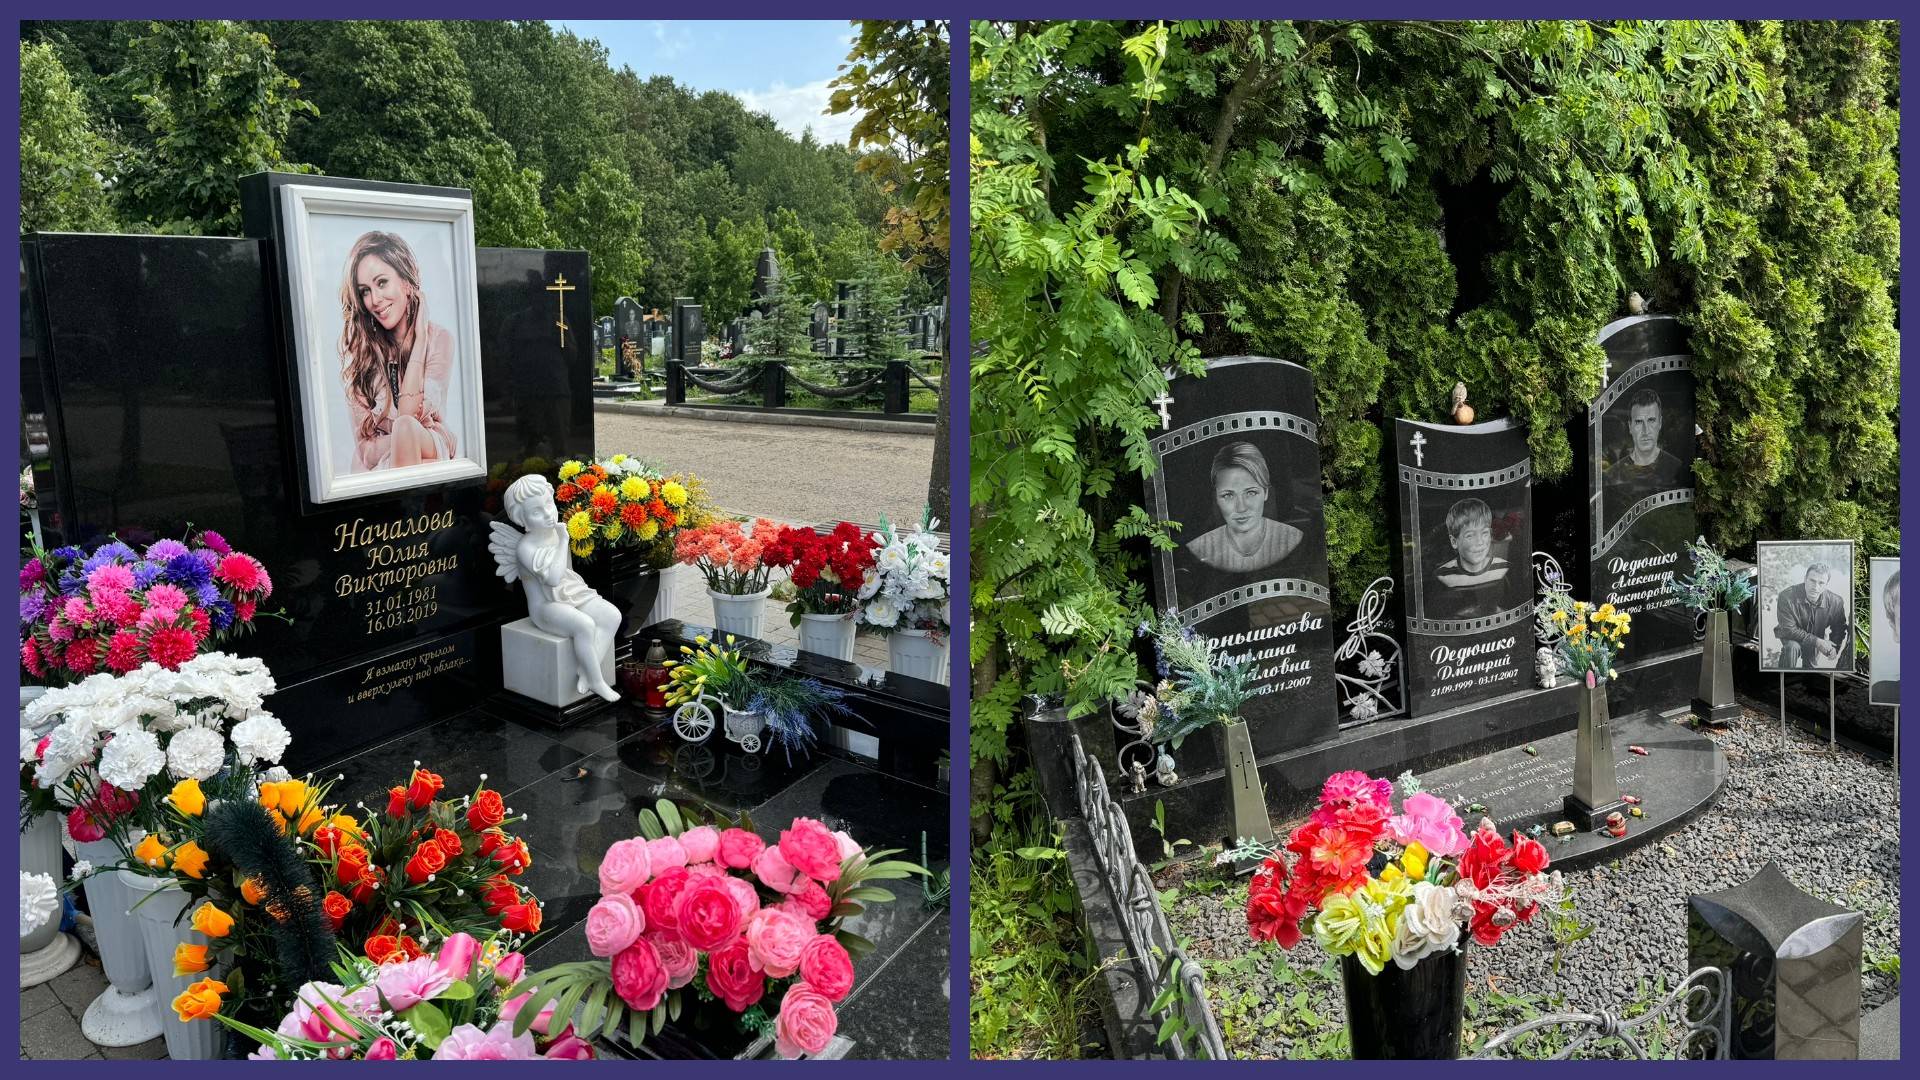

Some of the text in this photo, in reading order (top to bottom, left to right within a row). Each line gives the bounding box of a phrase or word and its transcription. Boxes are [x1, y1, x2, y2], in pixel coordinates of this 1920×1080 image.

[333, 509, 455, 551] Началова
[367, 542, 430, 570] Юлия
[1607, 552, 1678, 577] Дедюшко
[335, 554, 459, 597] Викторовна
[1611, 570, 1674, 590] Александр
[365, 585, 438, 618] 31.01.1981
[366, 602, 439, 635] 16.03.2019
[1206, 611, 1324, 650] рнышкова
[361, 643, 455, 684] Я взмахну крылом
[1430, 636, 1517, 666] Дедюшко
[1437, 654, 1511, 681] Дмитрий
[347, 695, 354, 704] и
[357, 683, 386, 700] вверх
[386, 674, 413, 695] улечу
[415, 664, 432, 681] под
[1430, 679, 1474, 697] 21.09.1999
[1478, 669, 1519, 686] 03.11.2007
[1430, 779, 1465, 794] ердце
[1489, 768, 1504, 776] не
[1507, 757, 1542, 771] верит
[1481, 766, 1574, 799] дверь открыли
